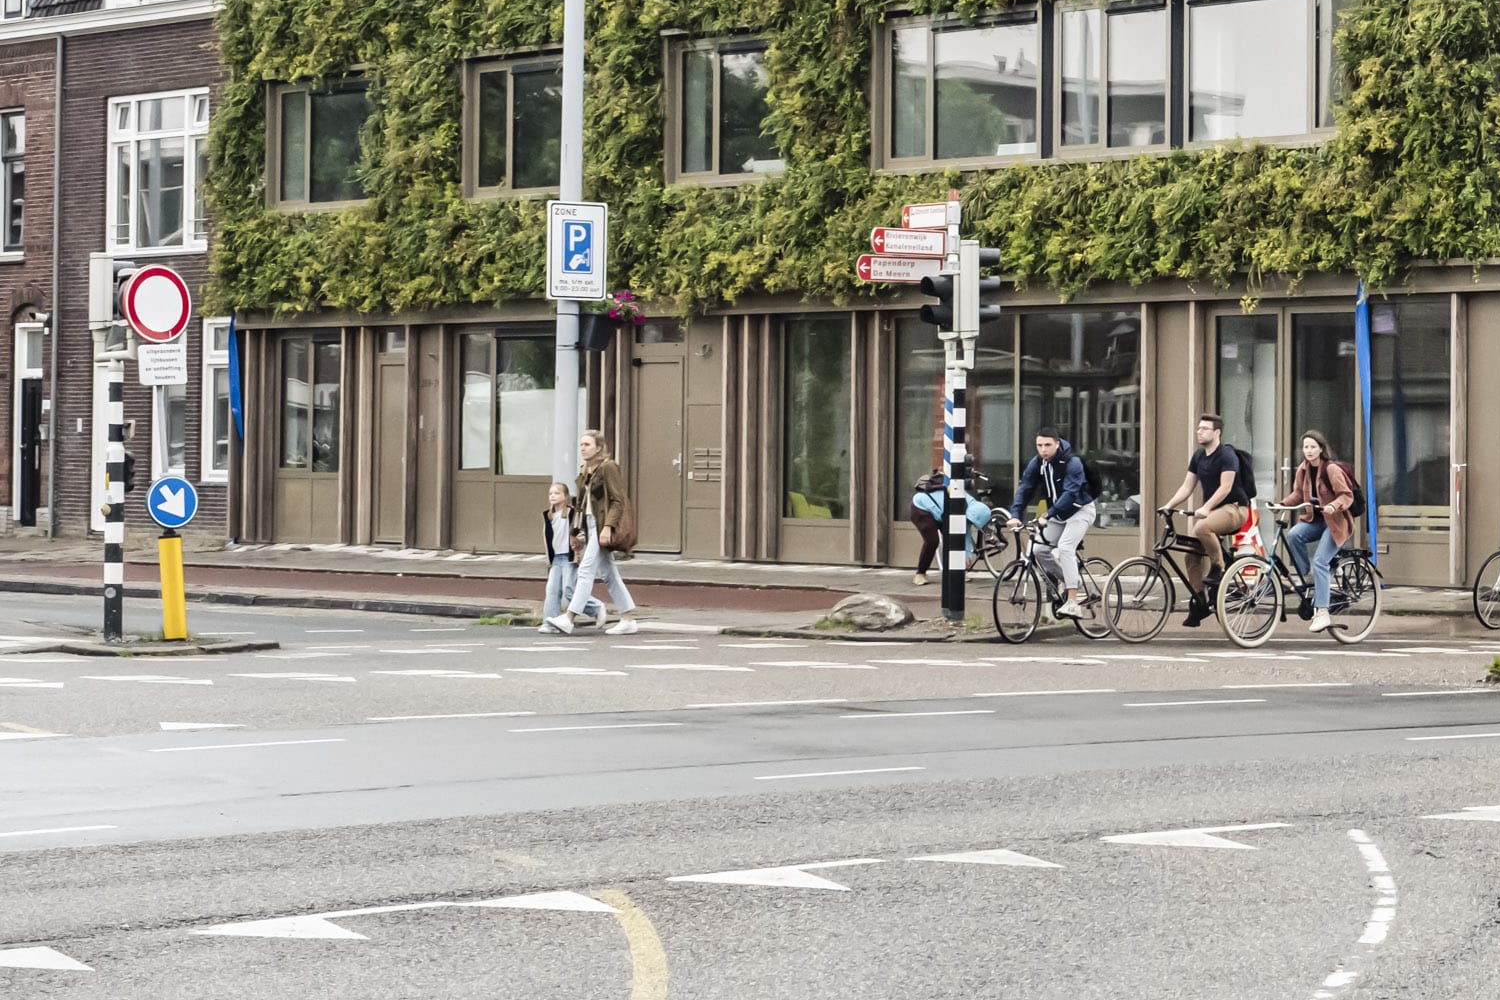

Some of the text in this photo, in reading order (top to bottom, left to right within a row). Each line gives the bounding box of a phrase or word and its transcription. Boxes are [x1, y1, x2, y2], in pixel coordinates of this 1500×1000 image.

[554, 208, 577, 216] ZONE
[569, 224, 587, 251] P
[873, 260, 915, 268] Papendorp
